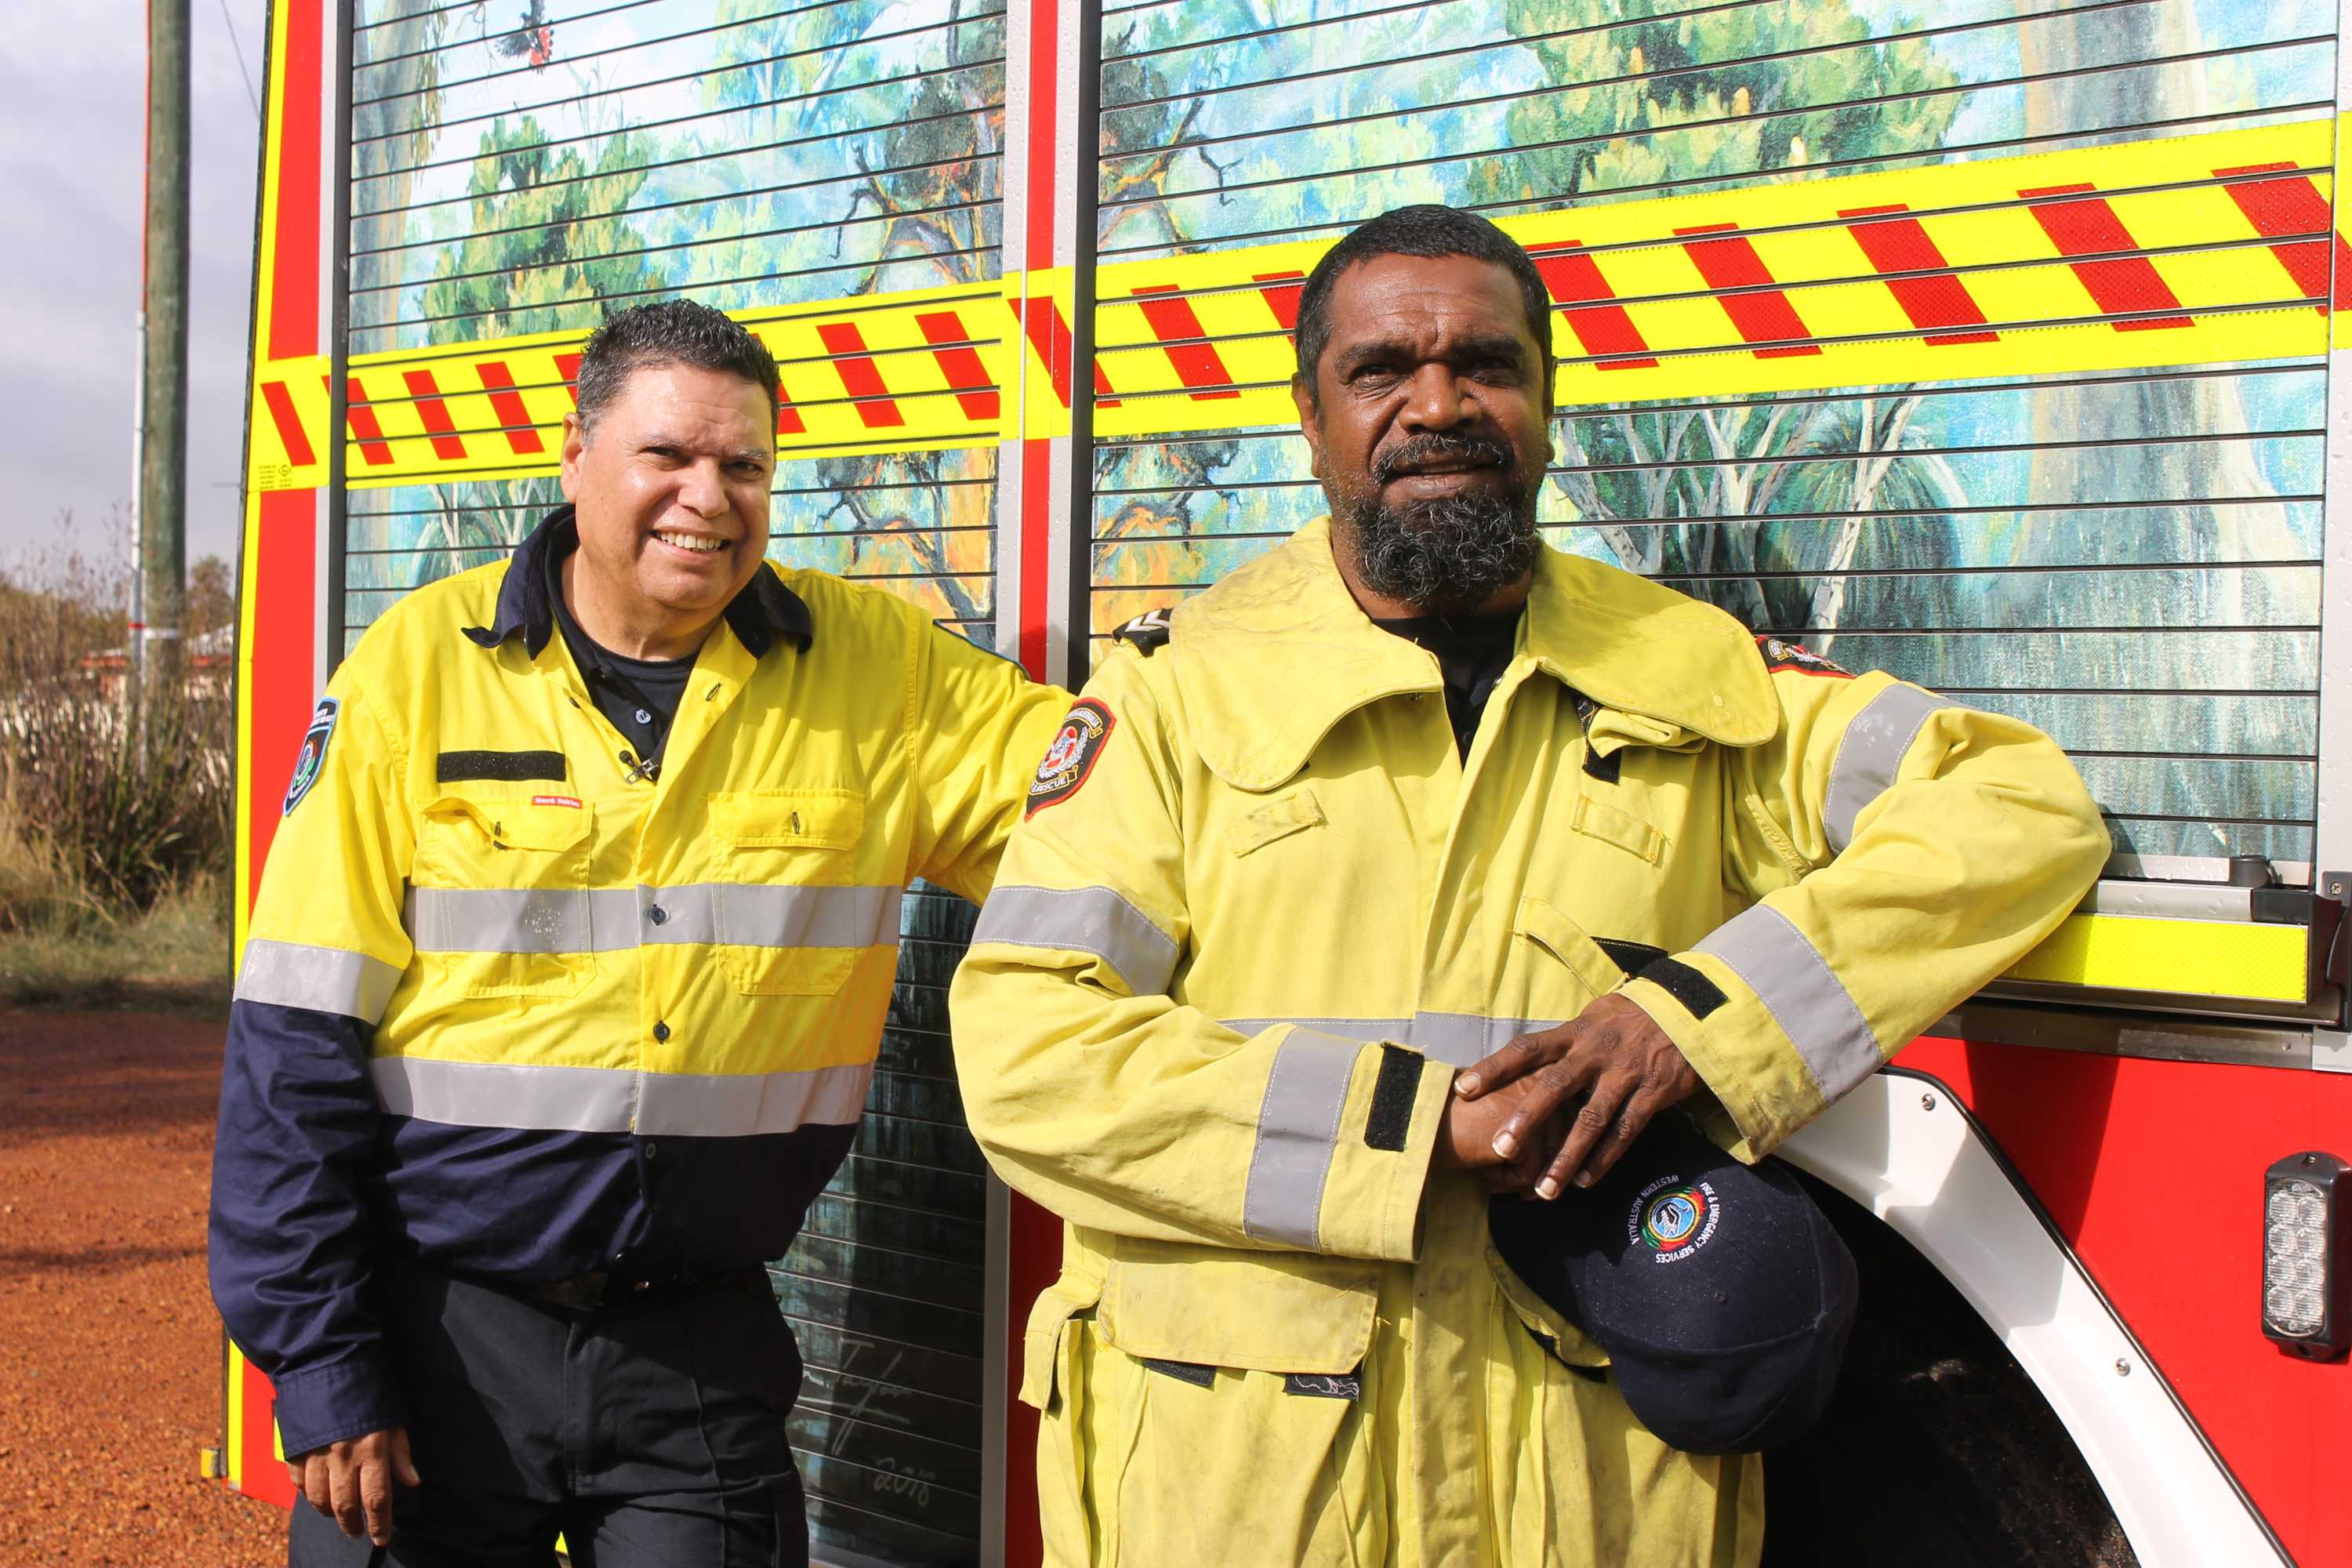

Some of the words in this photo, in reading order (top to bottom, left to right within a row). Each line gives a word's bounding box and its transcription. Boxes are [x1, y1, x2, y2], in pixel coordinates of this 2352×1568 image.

[1640, 1175, 1679, 1198] WESTERN
[1700, 1181, 1715, 1196] FIRE
[1628, 1197, 1644, 1245] AUSTRALIA
[1695, 1203, 1720, 1249] EMERGENCY
[1655, 1245, 1695, 1263] SERVICES
